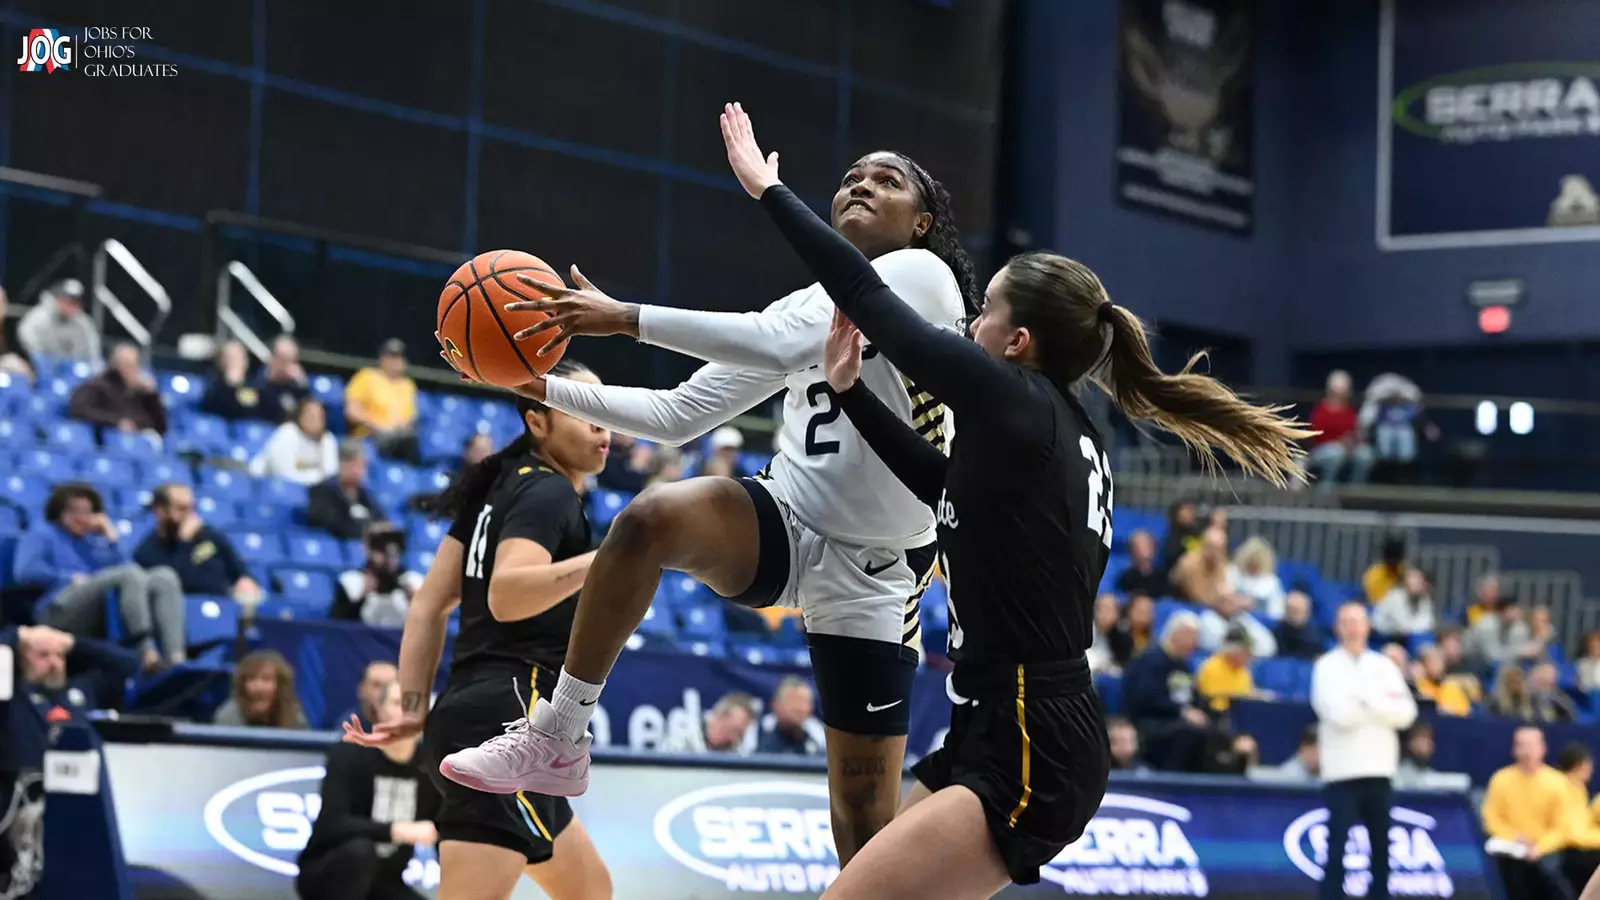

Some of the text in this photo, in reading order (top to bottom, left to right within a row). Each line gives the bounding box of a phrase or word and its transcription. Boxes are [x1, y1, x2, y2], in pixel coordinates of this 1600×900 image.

[805, 380, 842, 456] 2
[692, 805, 839, 860] SERR
[1048, 817, 1199, 866] ERRA
